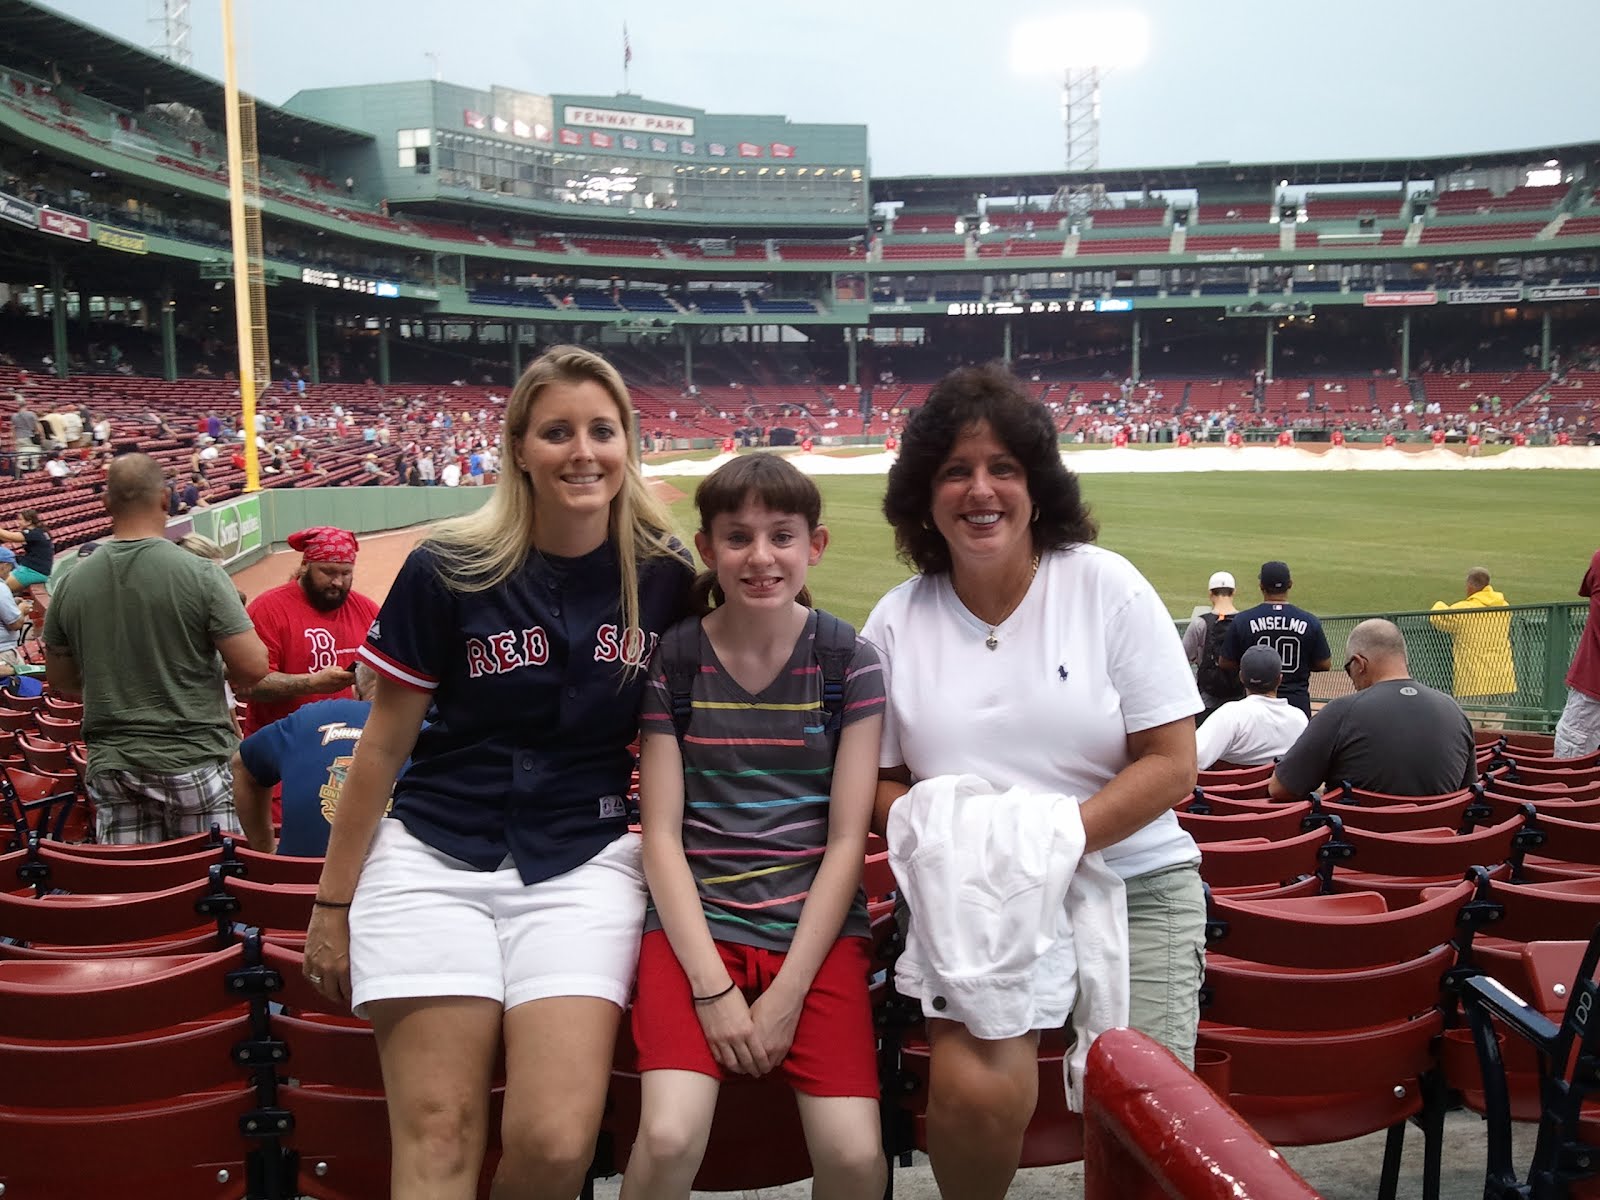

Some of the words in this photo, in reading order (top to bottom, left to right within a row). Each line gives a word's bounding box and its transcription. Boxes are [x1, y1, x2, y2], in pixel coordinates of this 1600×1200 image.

[573, 111, 637, 127] FENWAY
[645, 118, 686, 131] PARK
[1250, 616, 1308, 635] ANSELMO
[304, 628, 337, 674] B
[466, 626, 549, 678] RED
[1257, 635, 1301, 673] 0
[318, 722, 363, 746] Tomm
[1575, 991, 1592, 1025] DD
